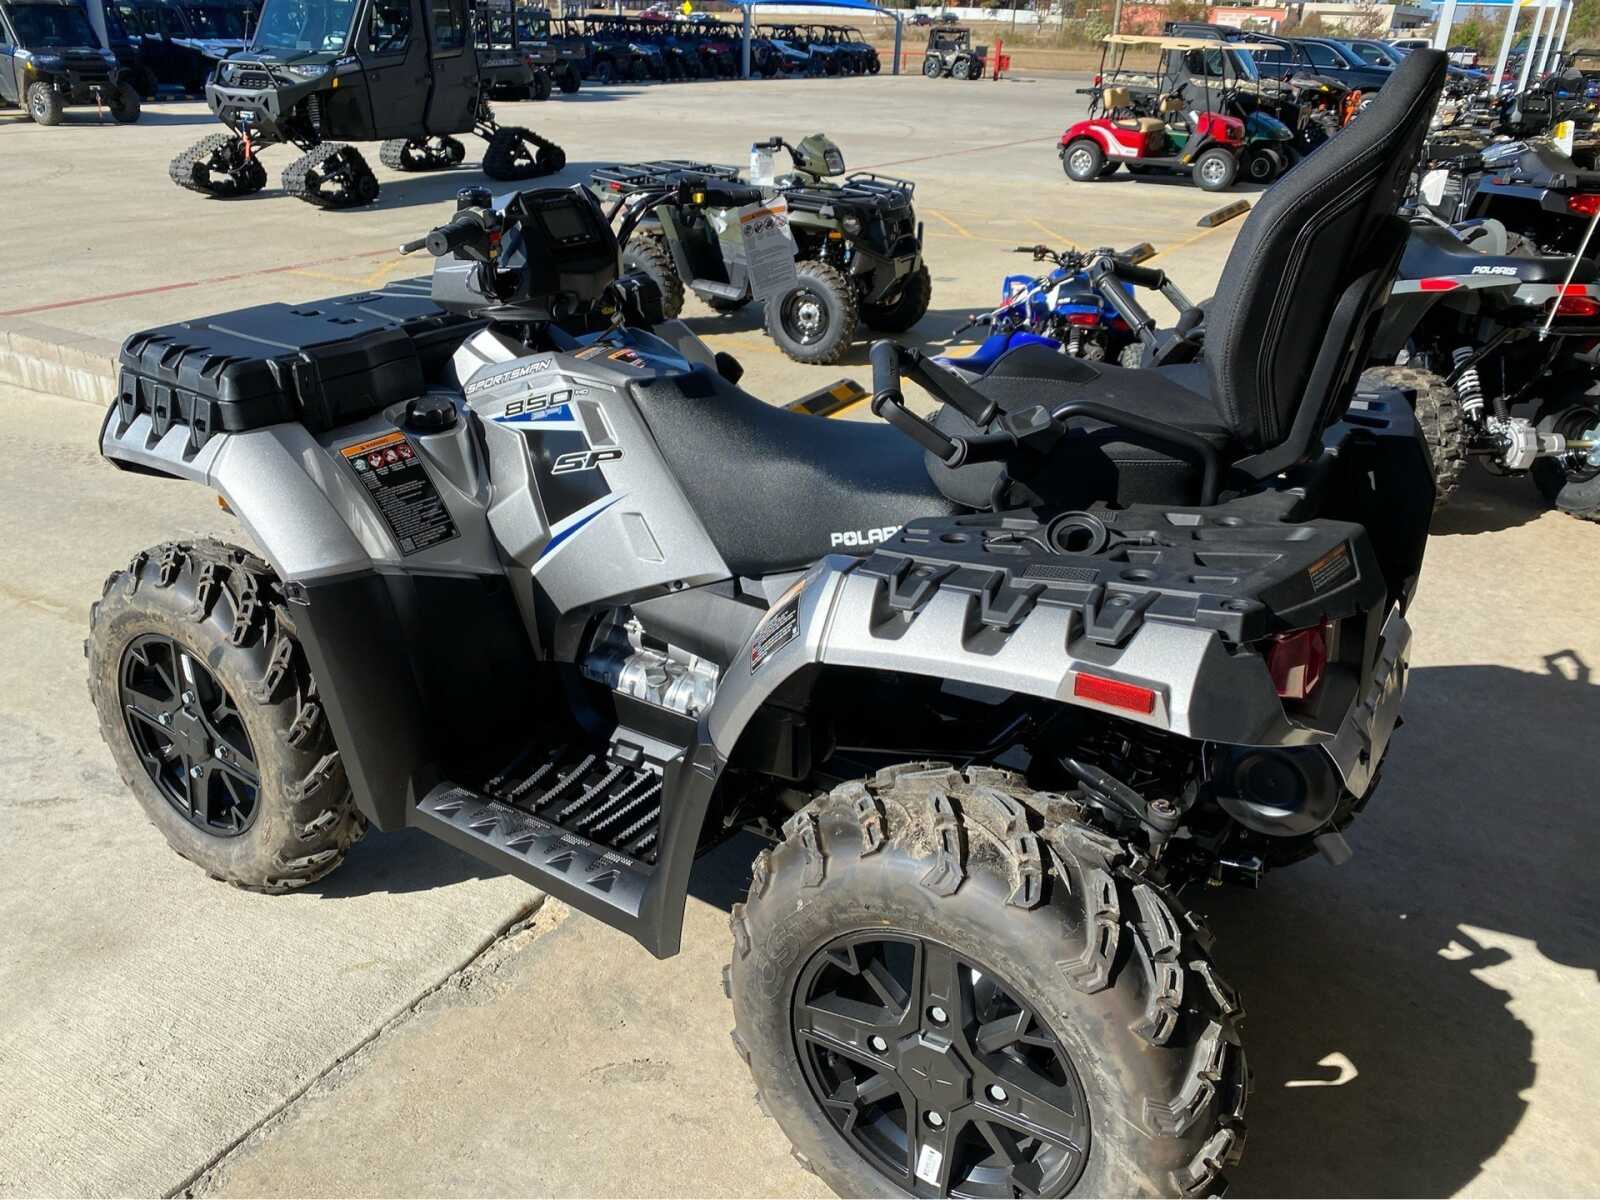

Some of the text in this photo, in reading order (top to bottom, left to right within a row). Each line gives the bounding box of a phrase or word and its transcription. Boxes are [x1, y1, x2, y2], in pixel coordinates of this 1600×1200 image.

[1471, 265, 1518, 276] POLARIS
[466, 358, 552, 395] SPORTSMAN
[504, 388, 575, 418] 850
[551, 449, 625, 476] SP
[830, 525, 903, 547] POLAR
